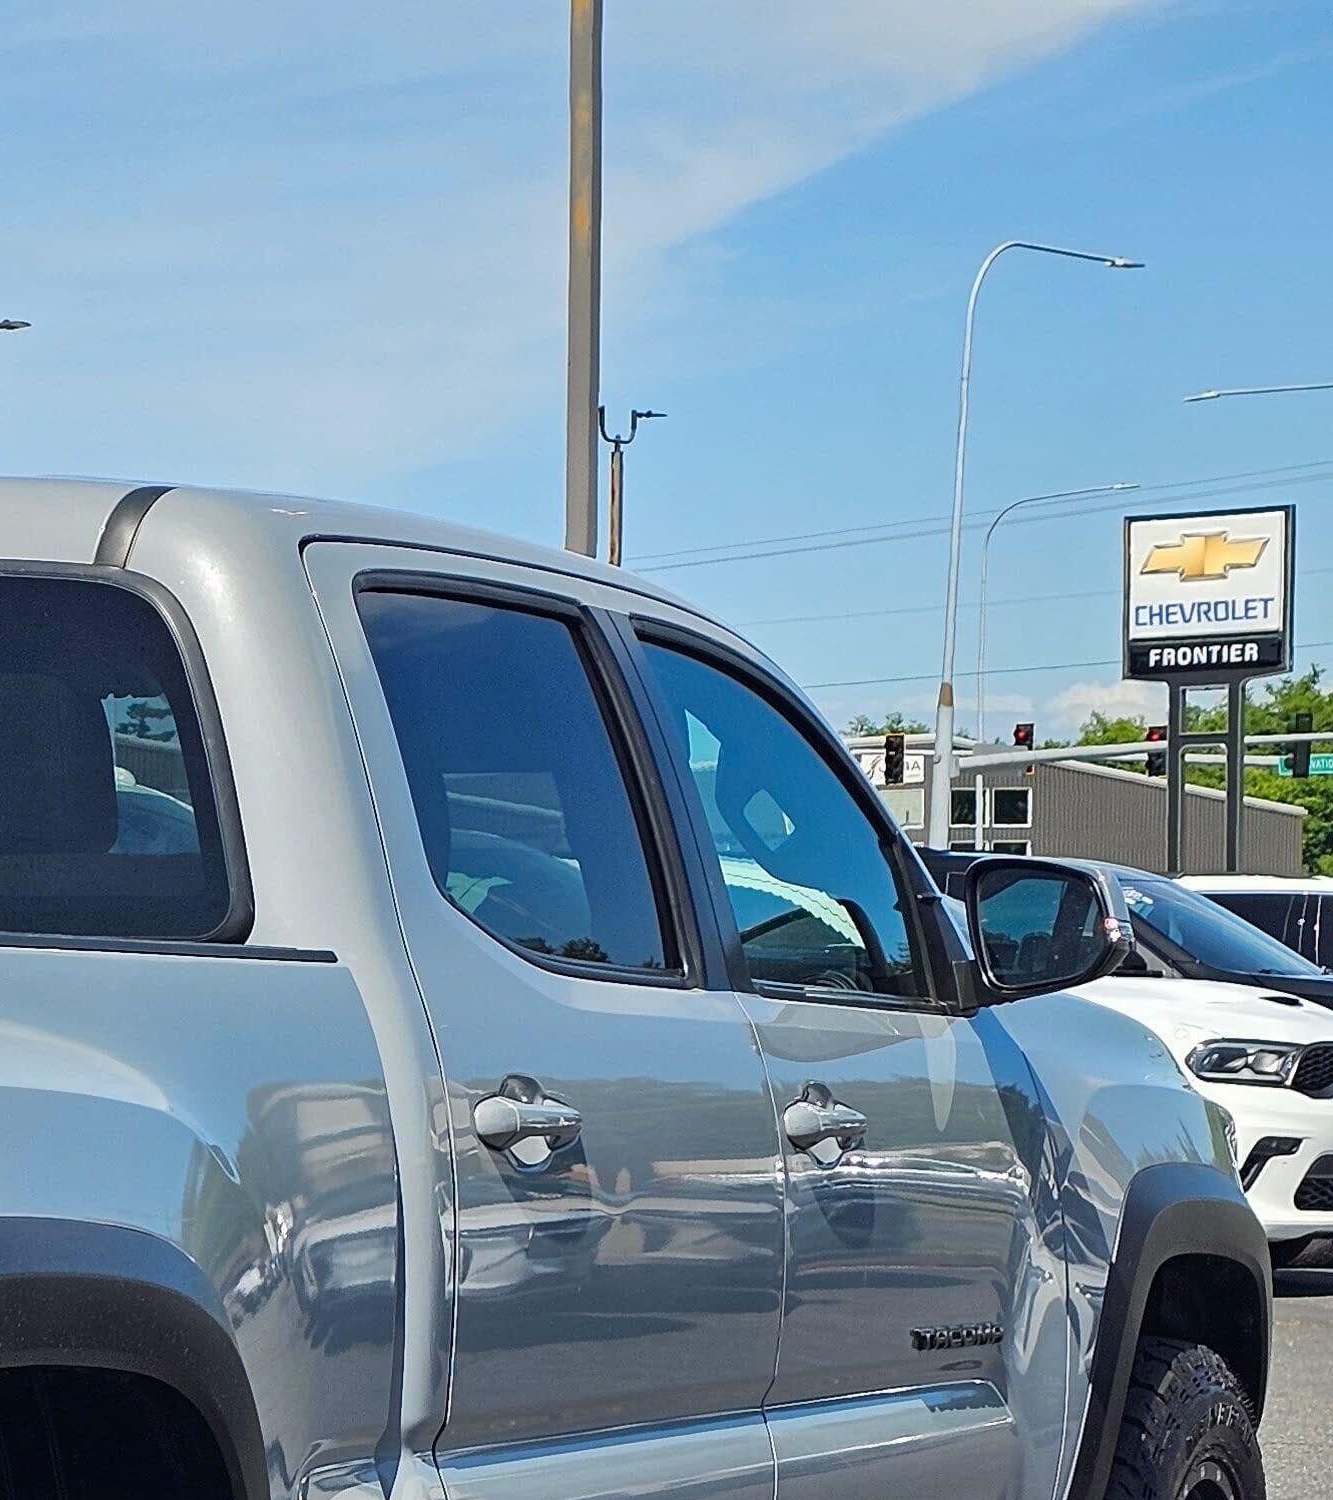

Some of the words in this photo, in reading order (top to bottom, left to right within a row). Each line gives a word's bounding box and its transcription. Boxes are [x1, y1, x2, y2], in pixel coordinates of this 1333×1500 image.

[1134, 597, 1275, 627] CHEVROLET
[1148, 642, 1259, 668] FRONTIER
[909, 1321, 1005, 1351] TACOMA
